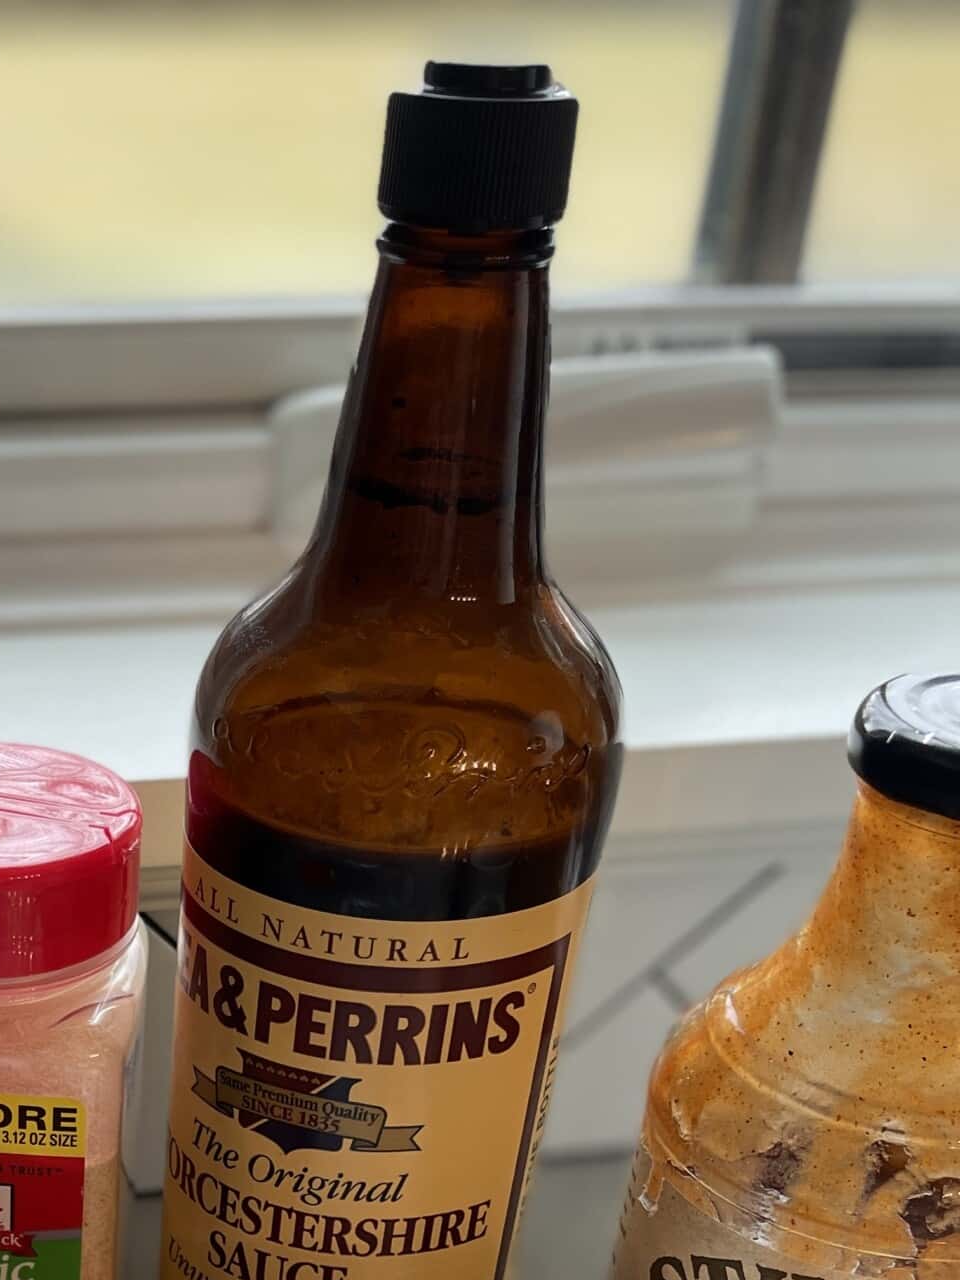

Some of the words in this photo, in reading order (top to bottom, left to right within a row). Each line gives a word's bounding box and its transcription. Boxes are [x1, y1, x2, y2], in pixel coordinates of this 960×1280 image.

[194, 878, 239, 924] ALL
[261, 912, 471, 962] NATURAL
[218, 1069, 250, 1094] Same
[252, 1078, 319, 1113] Premium
[321, 1099, 380, 1125] Quality
[241, 1095, 295, 1123] SINCE
[297, 1108, 339, 1134] 1835
[1, 1130, 26, 1145] 3.12
[29, 1132, 46, 1146] OZ
[49, 1132, 78, 1148] SIZE
[191, 1116, 239, 1170] The
[247, 1152, 409, 1206] Original
[10, 1164, 53, 1176] TRUST
[168, 1136, 492, 1258] ORCESTERSHIRE
